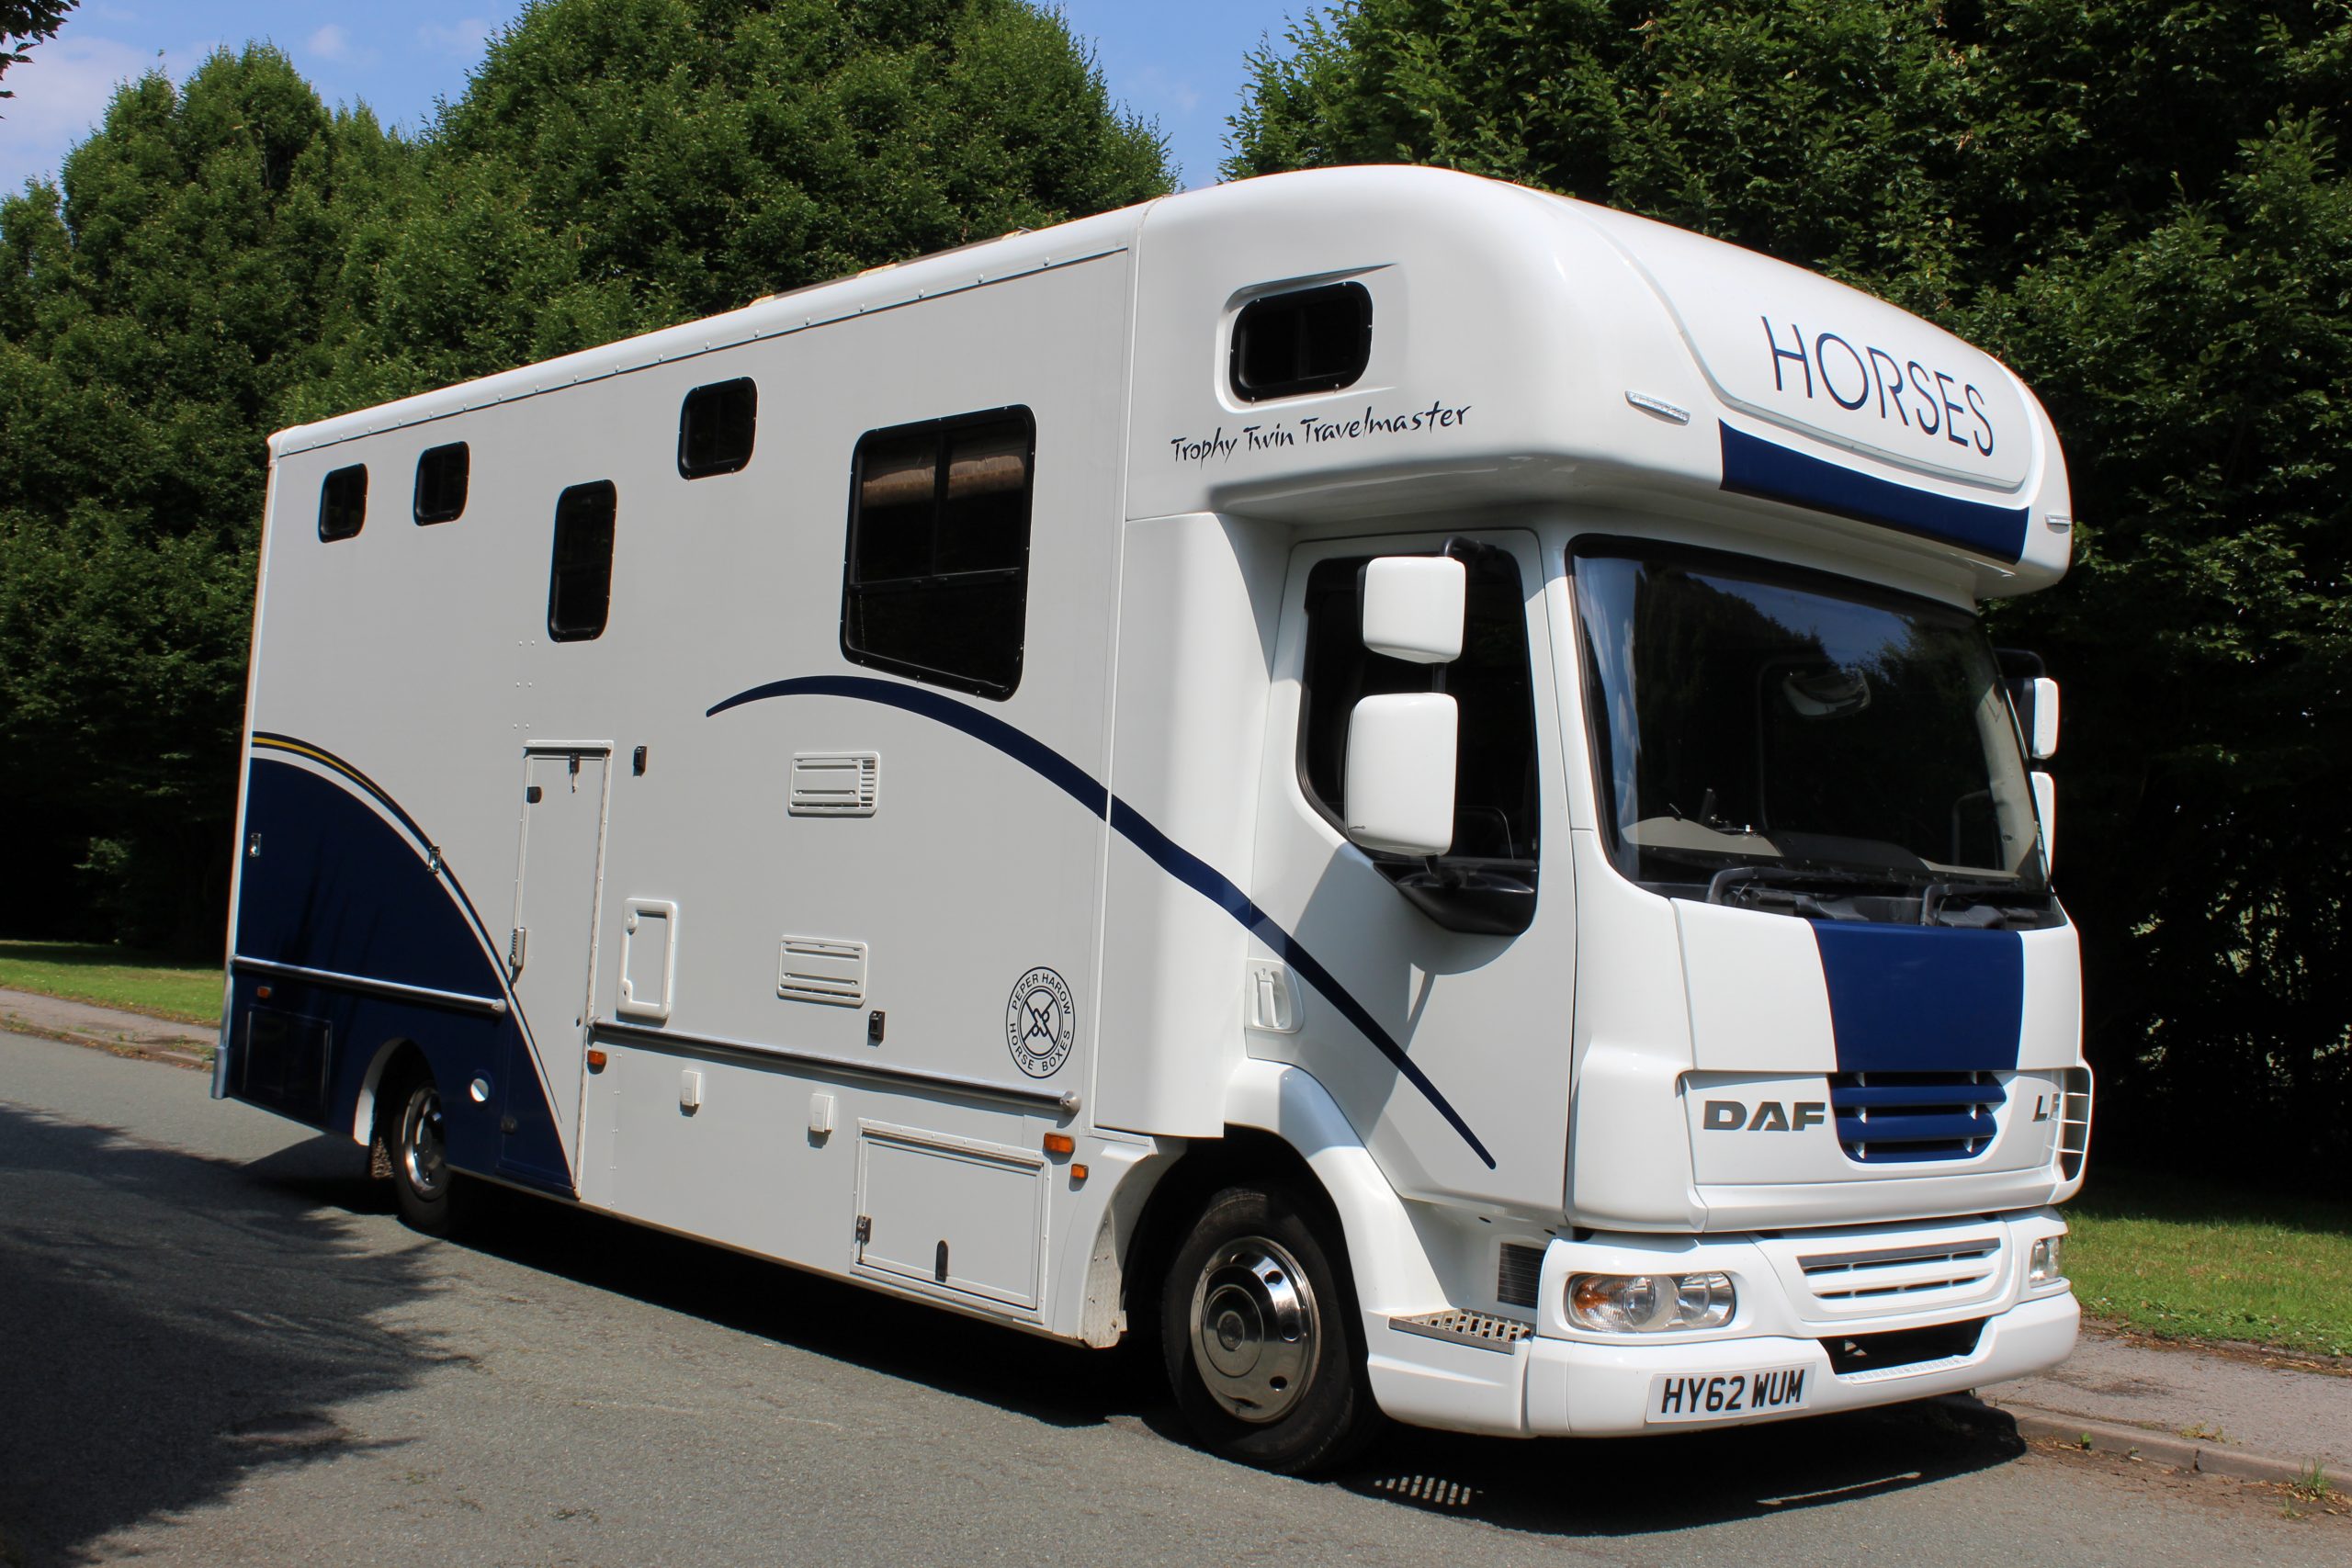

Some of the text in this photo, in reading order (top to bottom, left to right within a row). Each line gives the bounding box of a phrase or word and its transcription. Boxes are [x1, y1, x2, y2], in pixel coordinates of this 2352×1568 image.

[1759, 316, 1994, 457] HORSES
[1170, 400, 1472, 469] Trophy Twin Travelmaster
[1012, 973, 1071, 1015] PEPER HAROW
[1010, 1022, 1070, 1072] HORSE BOXES
[1703, 1100, 1826, 1131] DAF
[1661, 1369, 1804, 1414] HY62 WUM
